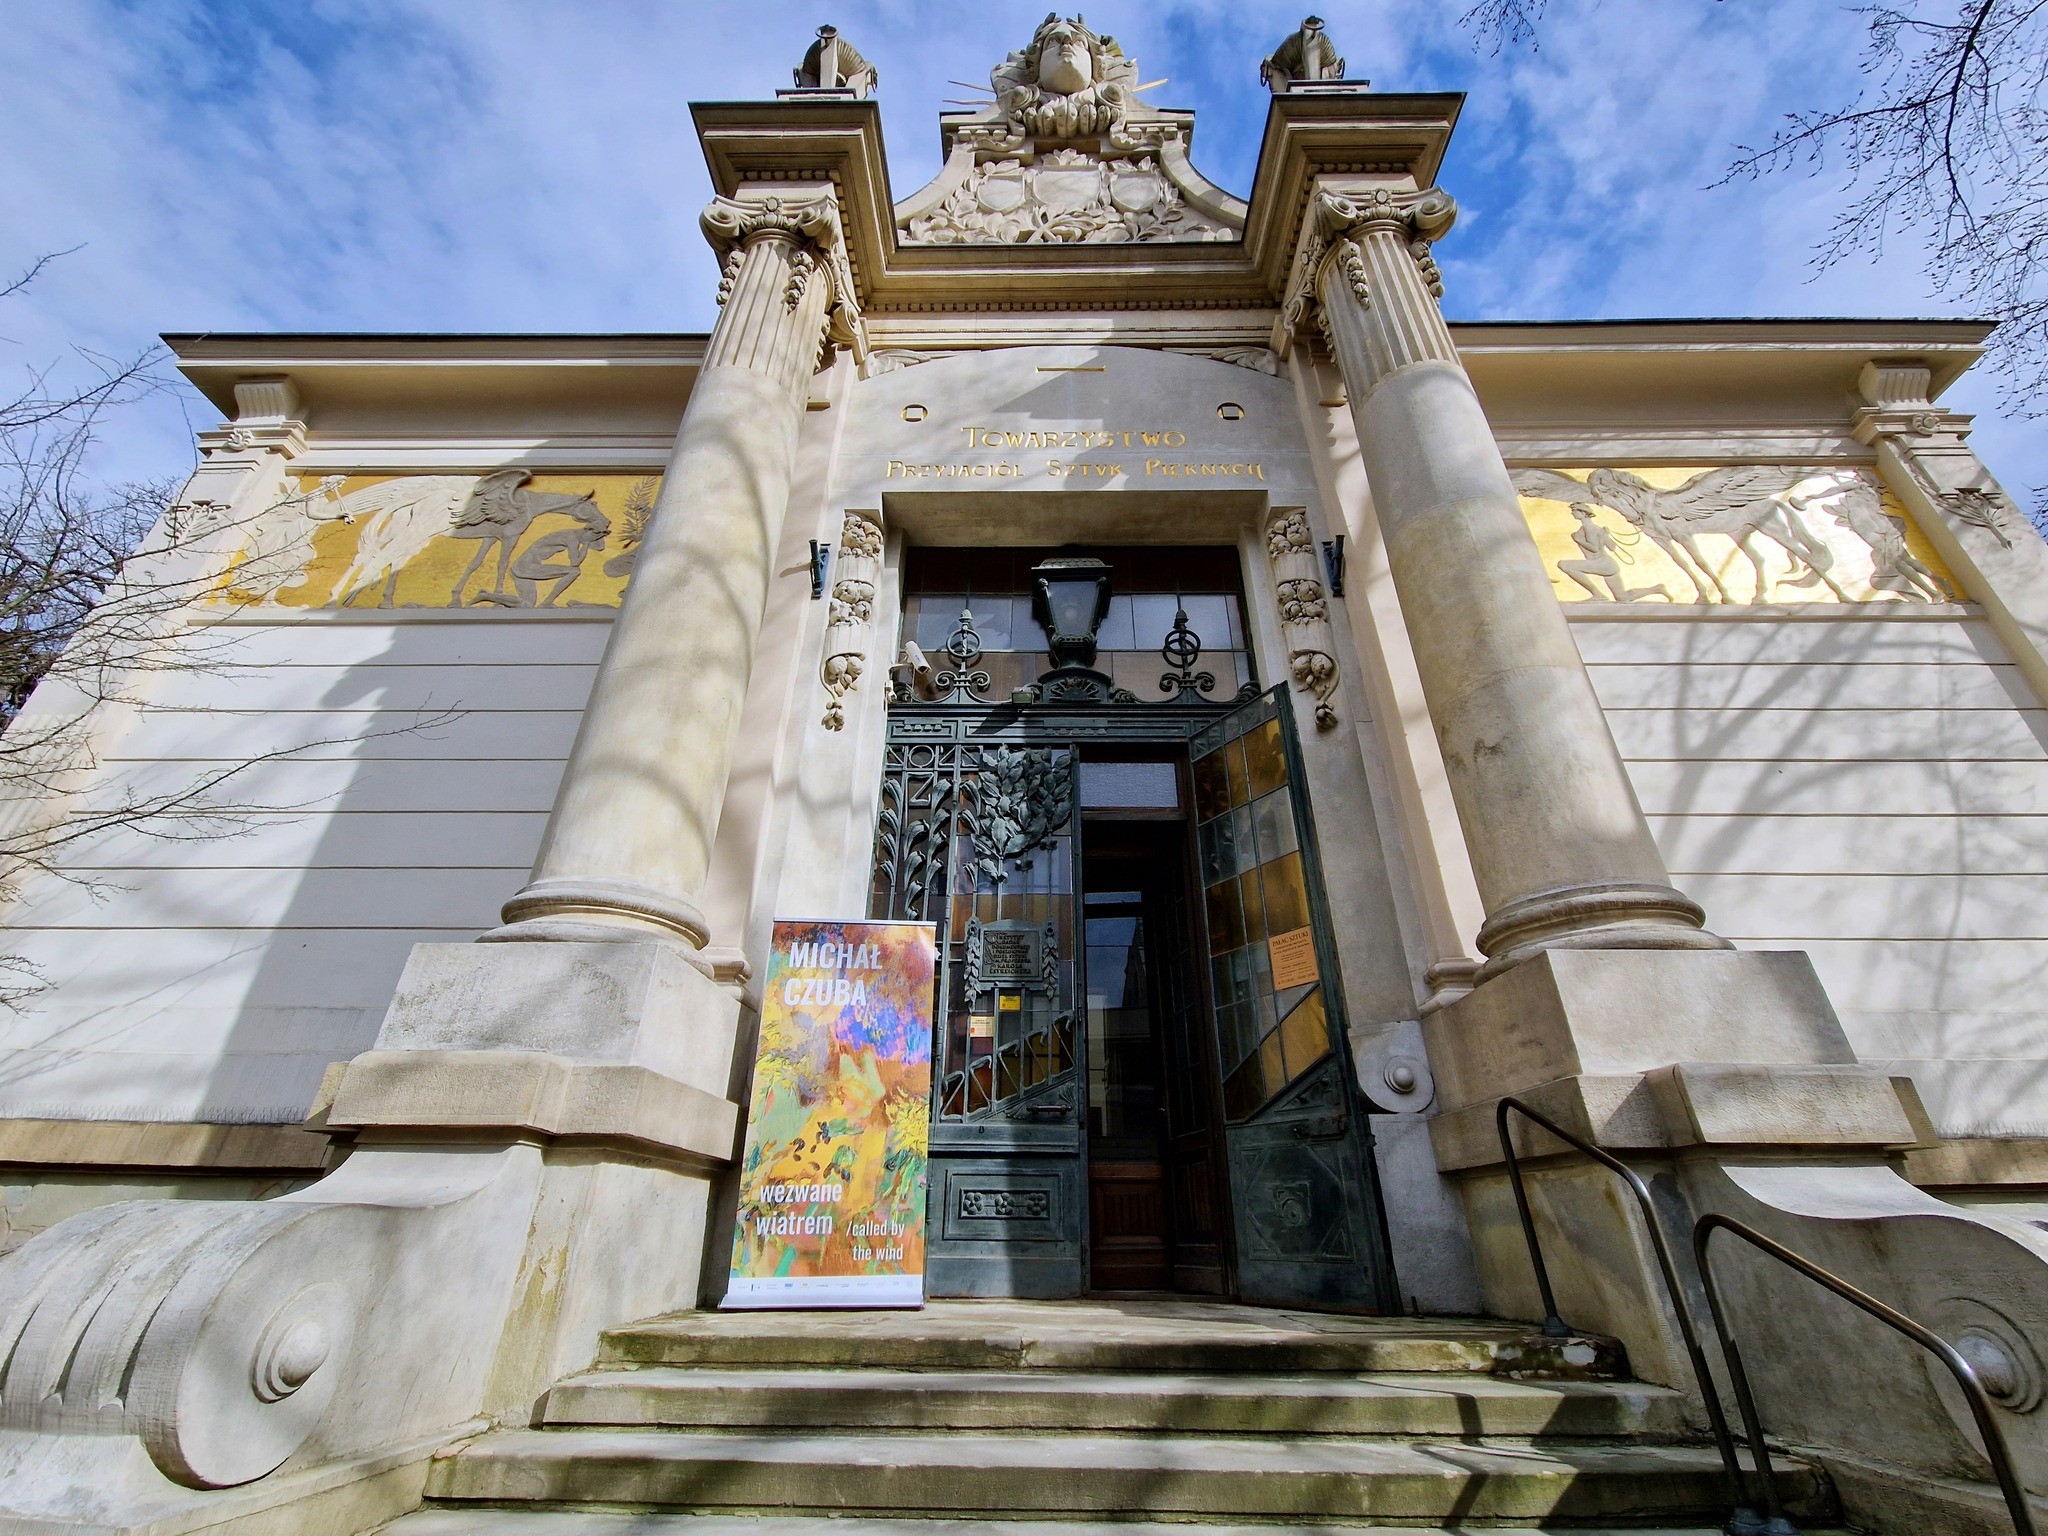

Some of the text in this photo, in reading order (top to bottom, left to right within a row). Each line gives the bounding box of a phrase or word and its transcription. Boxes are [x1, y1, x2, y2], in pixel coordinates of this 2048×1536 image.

[788, 941, 883, 970] MICHAŁ
[784, 978, 867, 1007] CZUBA
[760, 1183, 842, 1203] wezwane
[756, 1211, 833, 1236] wiatrem
[891, 1220, 905, 1239] by
[852, 1244, 903, 1261] the wind
